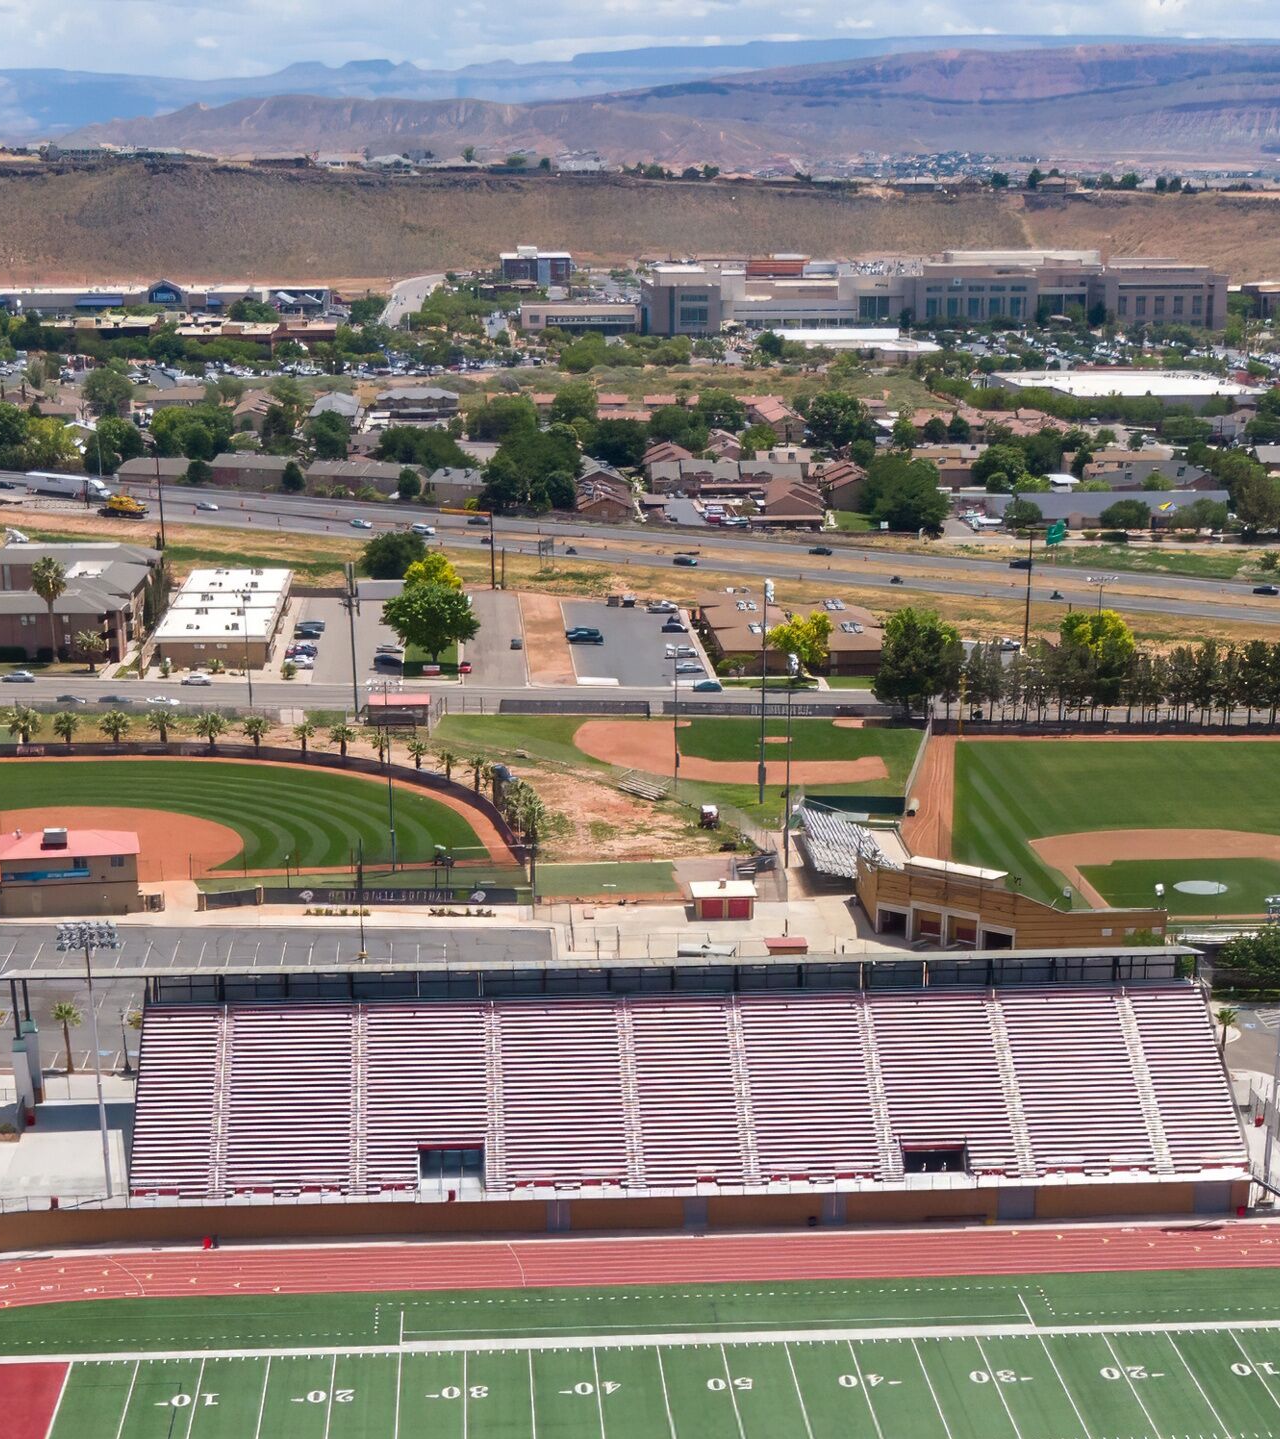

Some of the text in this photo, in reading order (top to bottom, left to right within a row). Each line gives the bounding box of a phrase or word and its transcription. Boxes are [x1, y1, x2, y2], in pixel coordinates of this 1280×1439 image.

[969, 1369, 1019, 1384] 30
[1100, 1365, 1150, 1380] 20
[1231, 1362, 1280, 1377] 10
[575, 1381, 622, 1395] 40
[707, 1376, 754, 1391] 50
[839, 1373, 888, 1388] 40
[307, 1389, 355, 1404] 20
[442, 1385, 488, 1399] 30
[171, 1393, 219, 1408] 10
